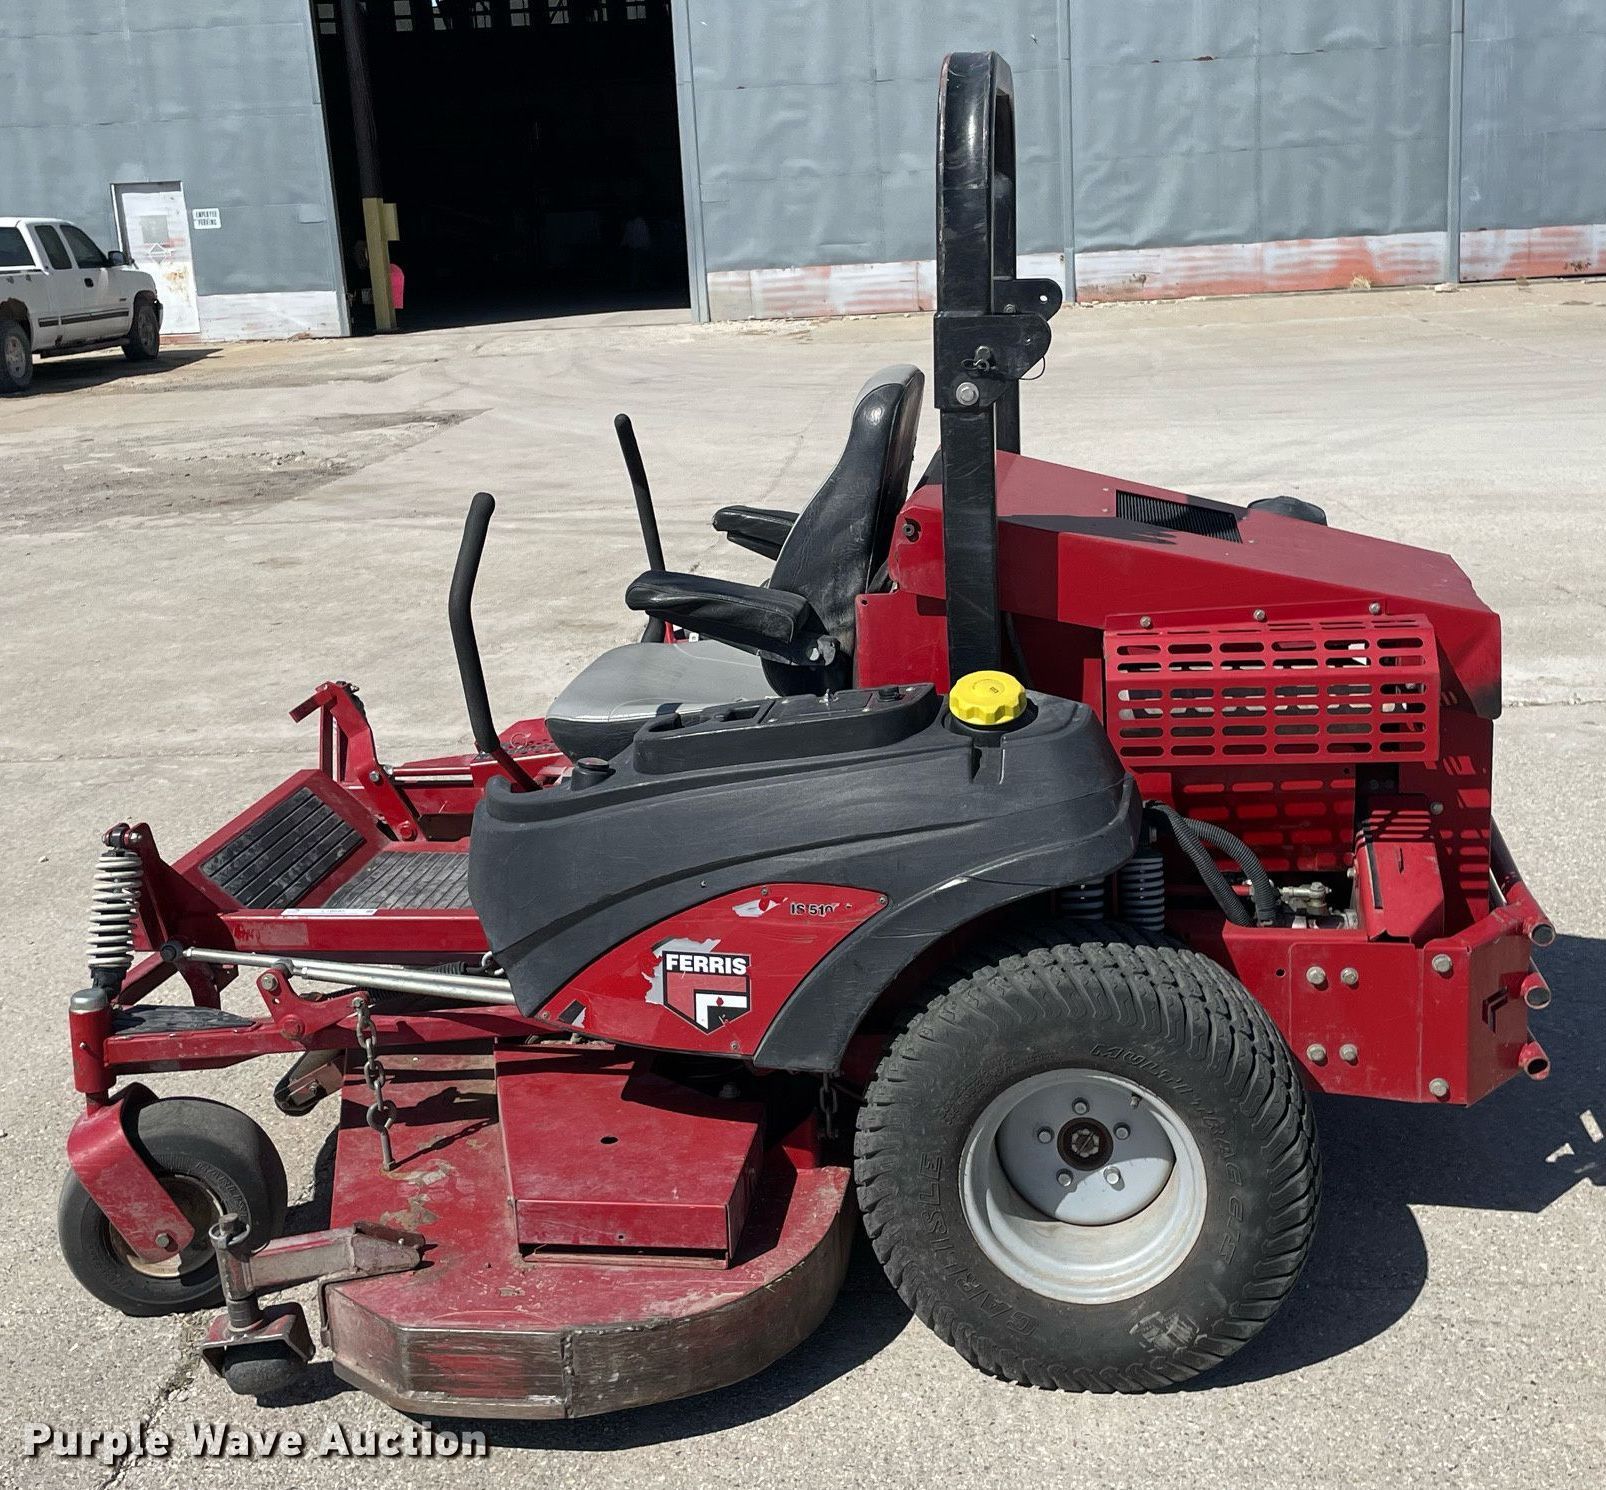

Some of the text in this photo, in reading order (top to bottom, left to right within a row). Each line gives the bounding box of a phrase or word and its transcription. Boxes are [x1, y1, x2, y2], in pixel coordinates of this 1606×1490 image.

[791, 903, 805, 915] IS
[665, 953, 747, 976] FERRIS
[917, 1150, 1040, 1337] CARLISLE
